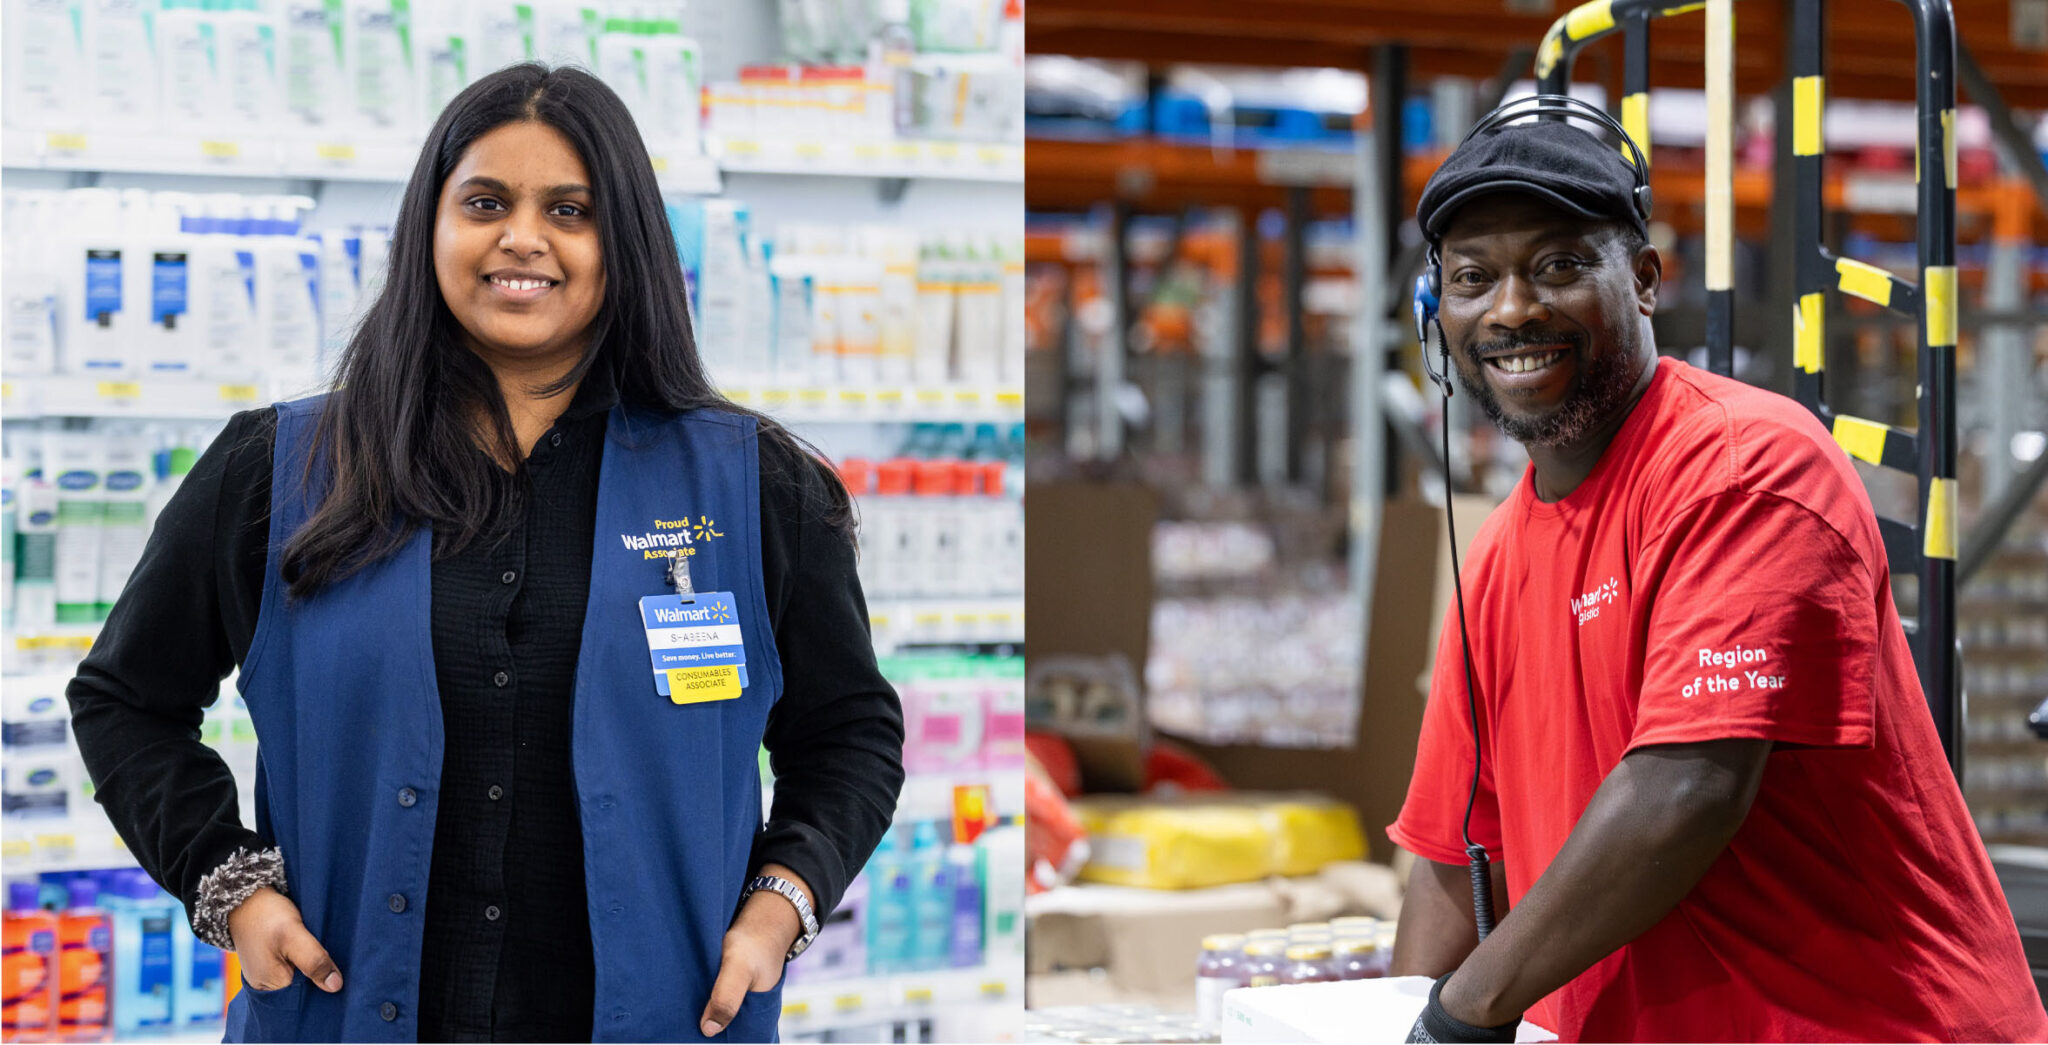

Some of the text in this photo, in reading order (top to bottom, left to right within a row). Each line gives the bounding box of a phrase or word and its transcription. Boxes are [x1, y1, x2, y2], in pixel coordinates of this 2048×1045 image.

[654, 516, 690, 530] Proud
[621, 530, 692, 550] Walmart
[654, 607, 710, 622] Walmart
[662, 654, 677, 662] Save
[701, 652, 714, 660] Live
[1698, 645, 1767, 669] Region
[676, 668, 731, 681] CONSUMABLES
[686, 679, 727, 690] ASSOCIATE
[1682, 670, 1786, 698] of the Year
